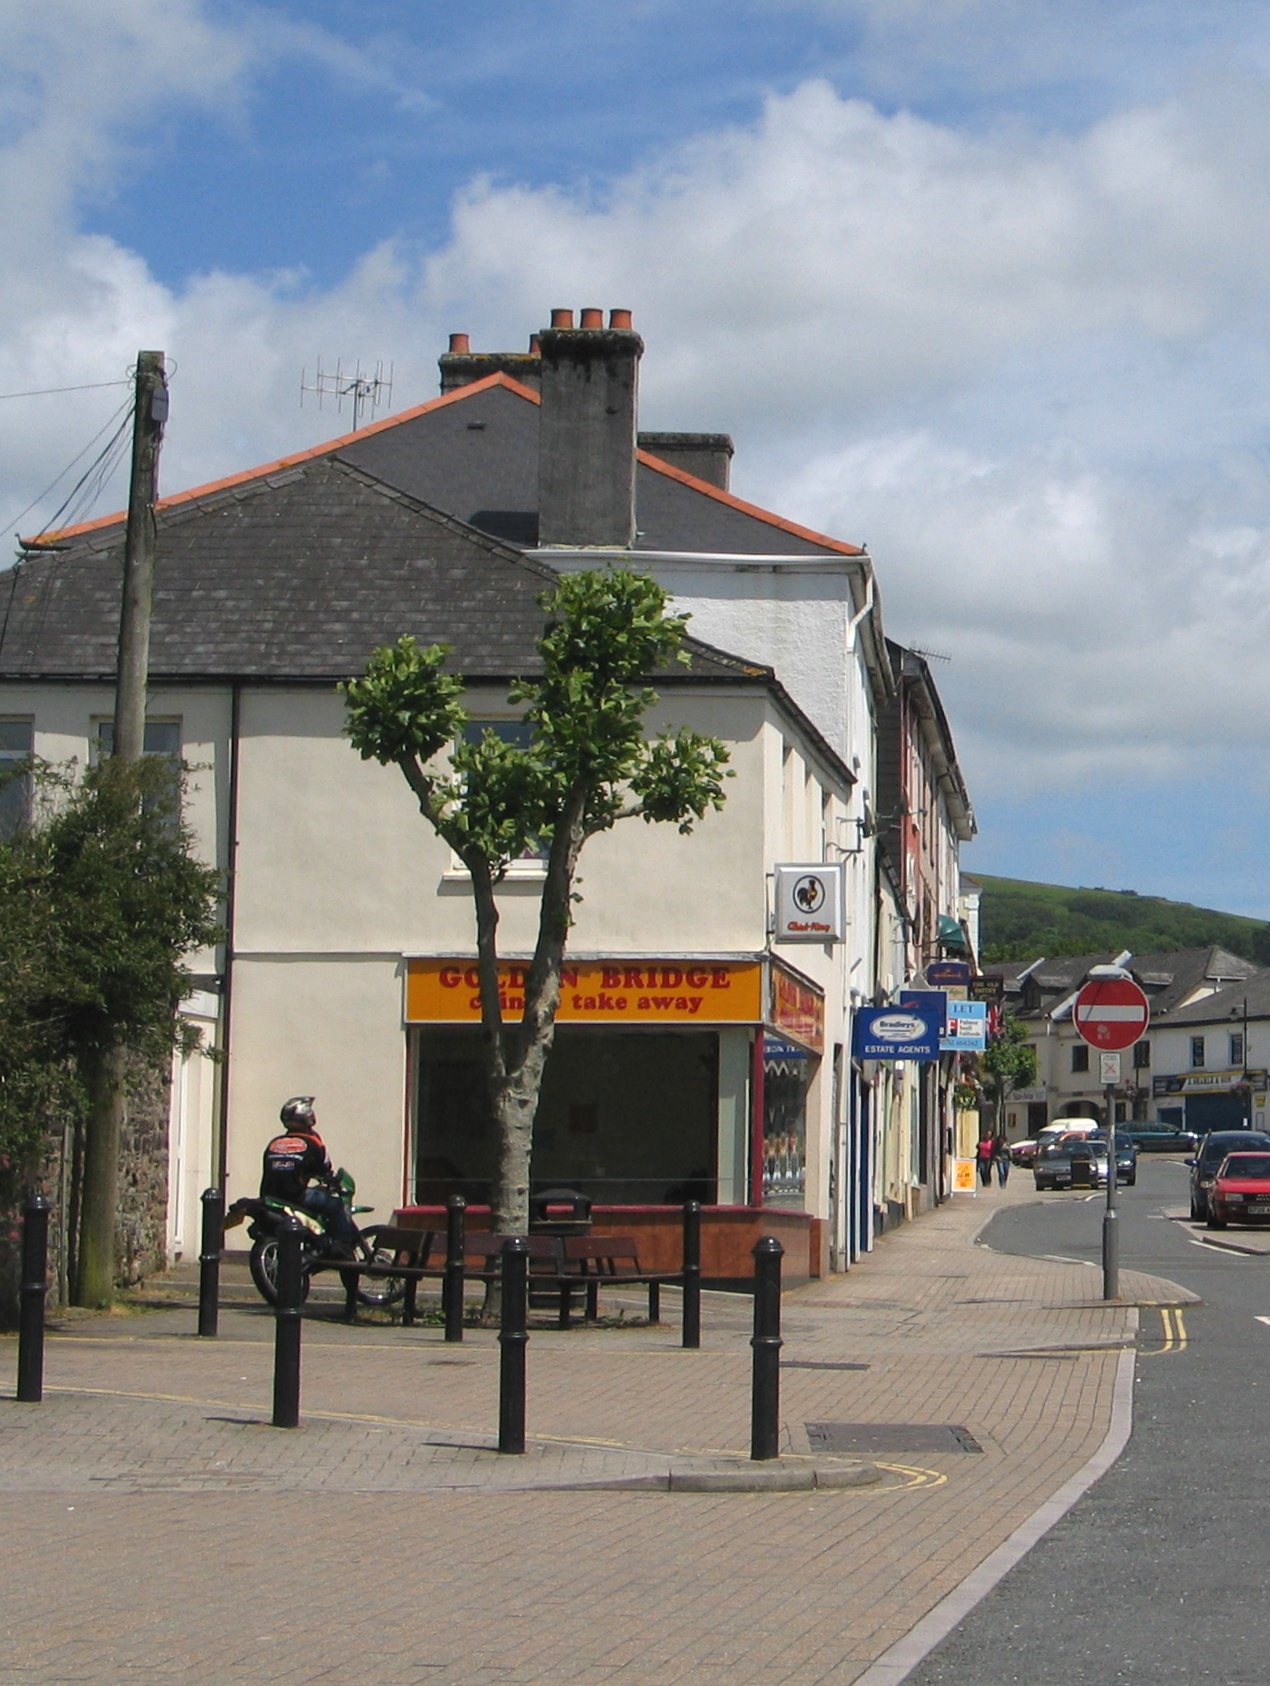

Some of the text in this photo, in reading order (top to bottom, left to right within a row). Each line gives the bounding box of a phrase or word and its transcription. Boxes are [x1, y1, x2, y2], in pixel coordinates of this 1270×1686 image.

[600, 966, 731, 989] BRIDGE
[572, 992, 627, 1011] take
[637, 996, 704, 1014] away
[953, 1004, 975, 1013] LET
[880, 1020, 915, 1029] Bradleys
[865, 1045, 930, 1053] ESTATE AGENTS
